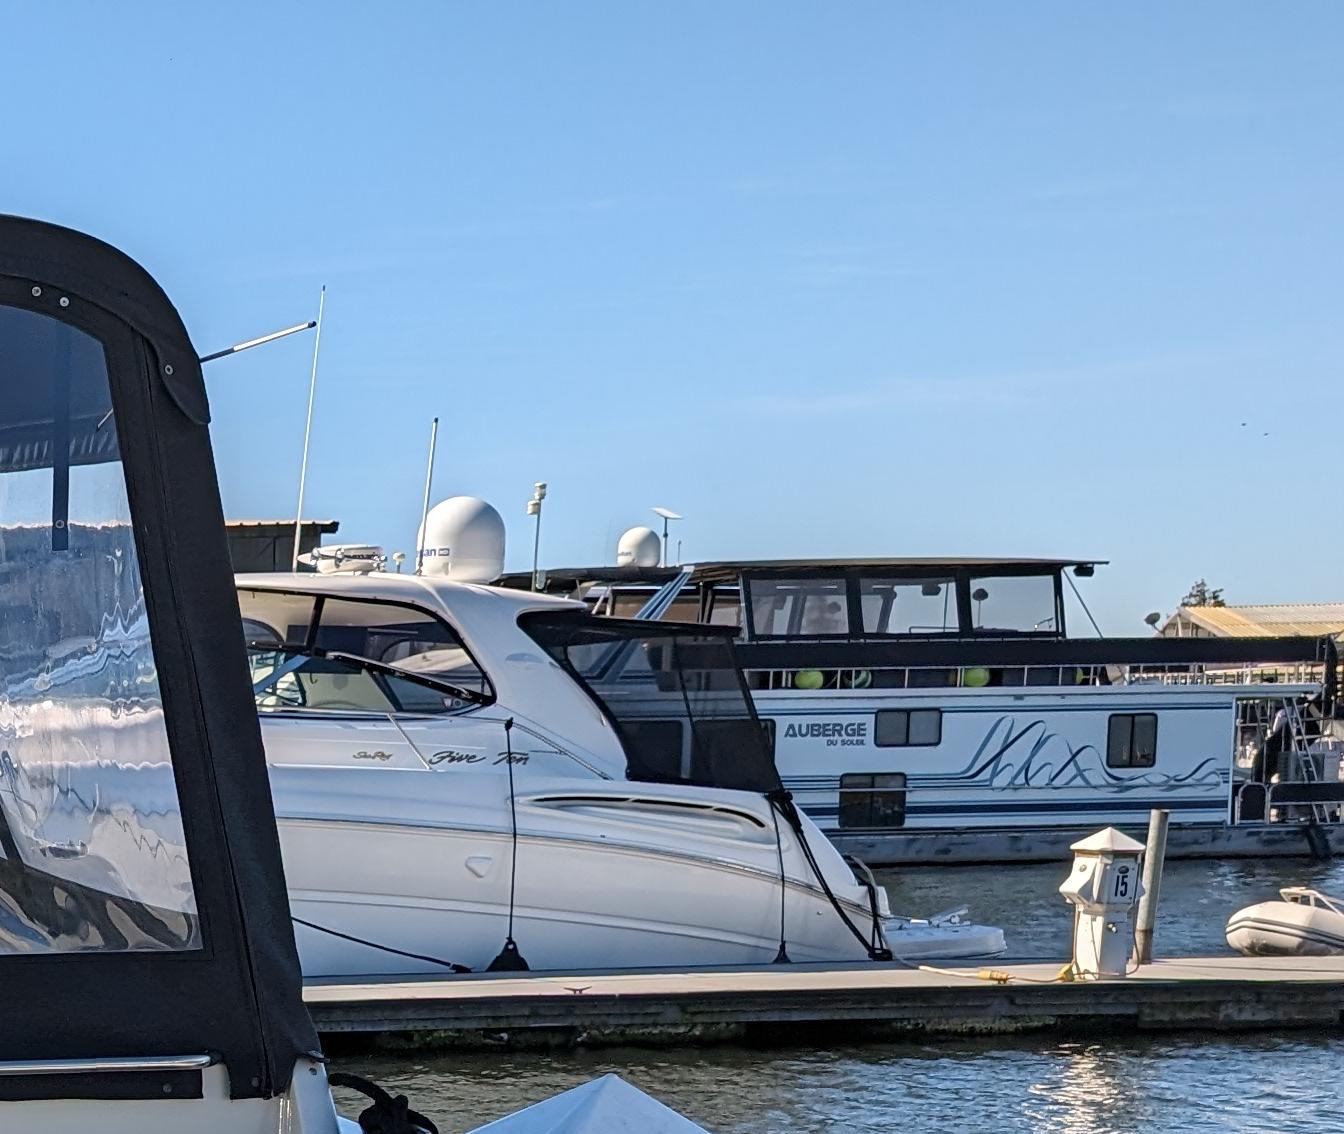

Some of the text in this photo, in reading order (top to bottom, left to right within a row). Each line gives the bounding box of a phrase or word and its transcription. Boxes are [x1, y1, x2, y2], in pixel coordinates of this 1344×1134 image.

[784, 723, 867, 738] AUBERGE
[429, 751, 529, 765] Five Ten
[1114, 875, 1129, 897] 15
